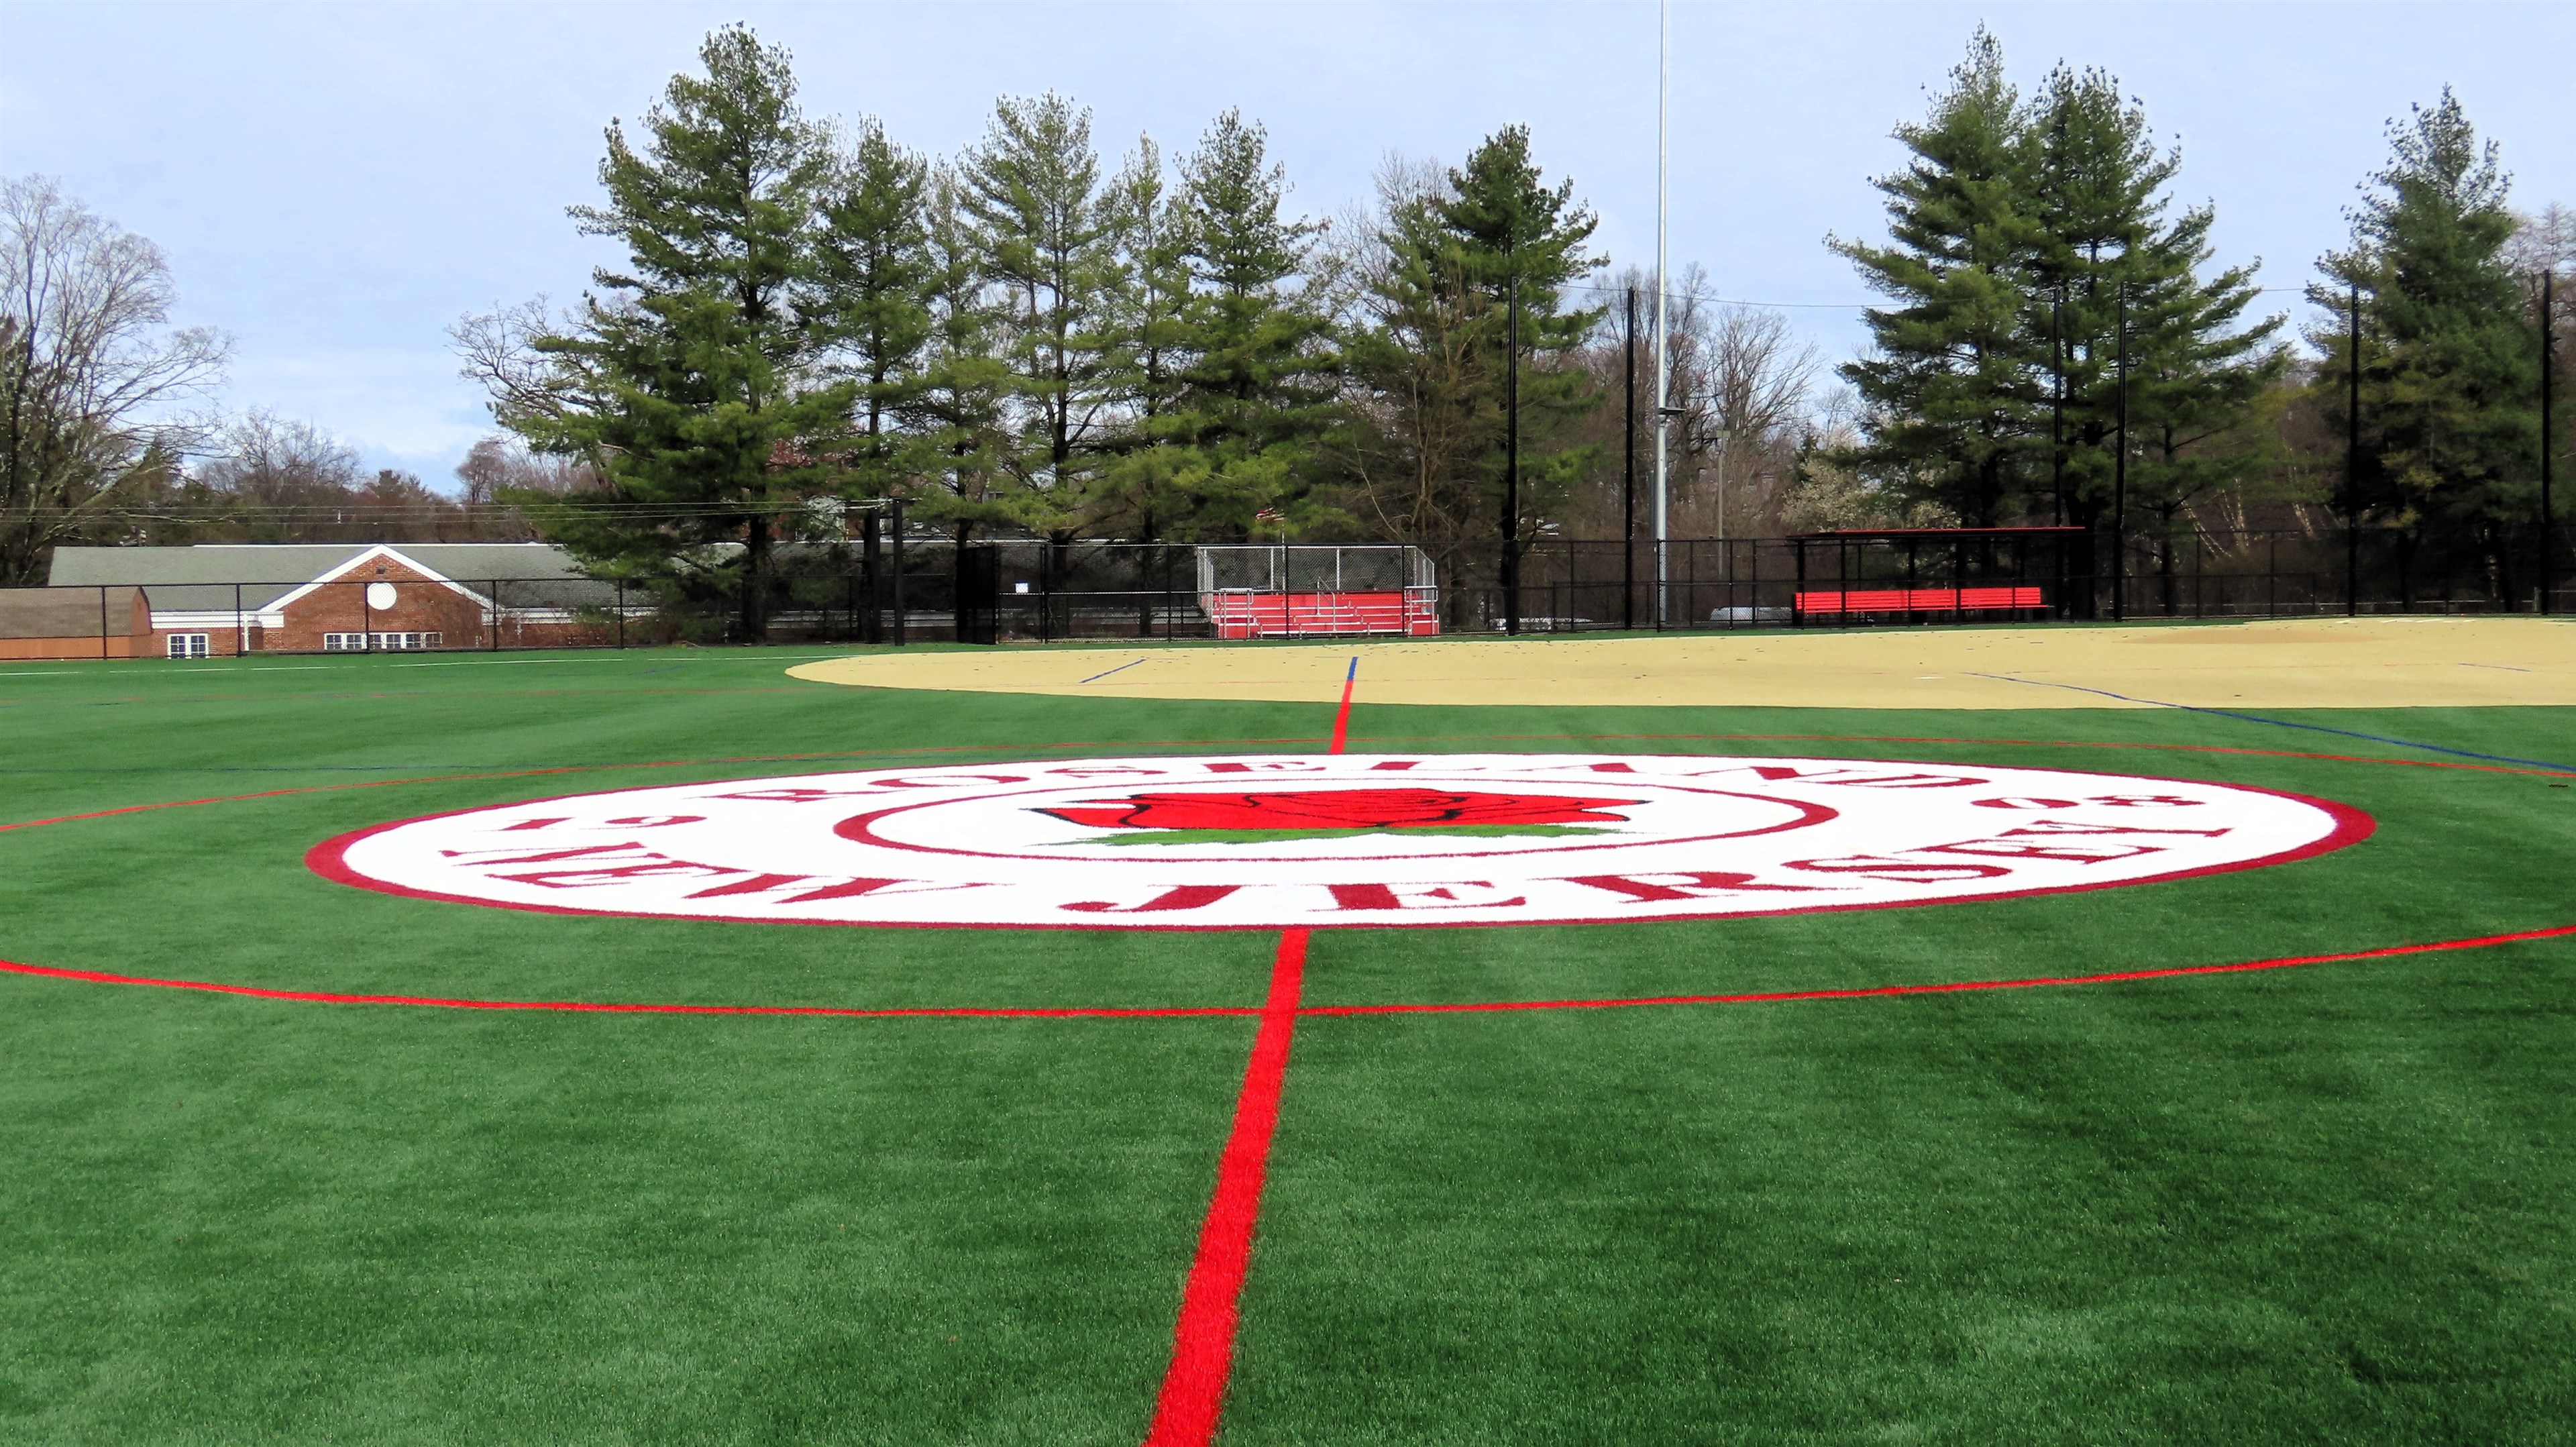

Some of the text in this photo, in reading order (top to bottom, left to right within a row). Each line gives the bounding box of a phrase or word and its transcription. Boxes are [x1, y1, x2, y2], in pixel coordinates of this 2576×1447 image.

[683, 762, 1990, 804] ROSELAND
[471, 794, 2206, 832] 19 08
[438, 820, 2234, 912] NEW JERSEY
